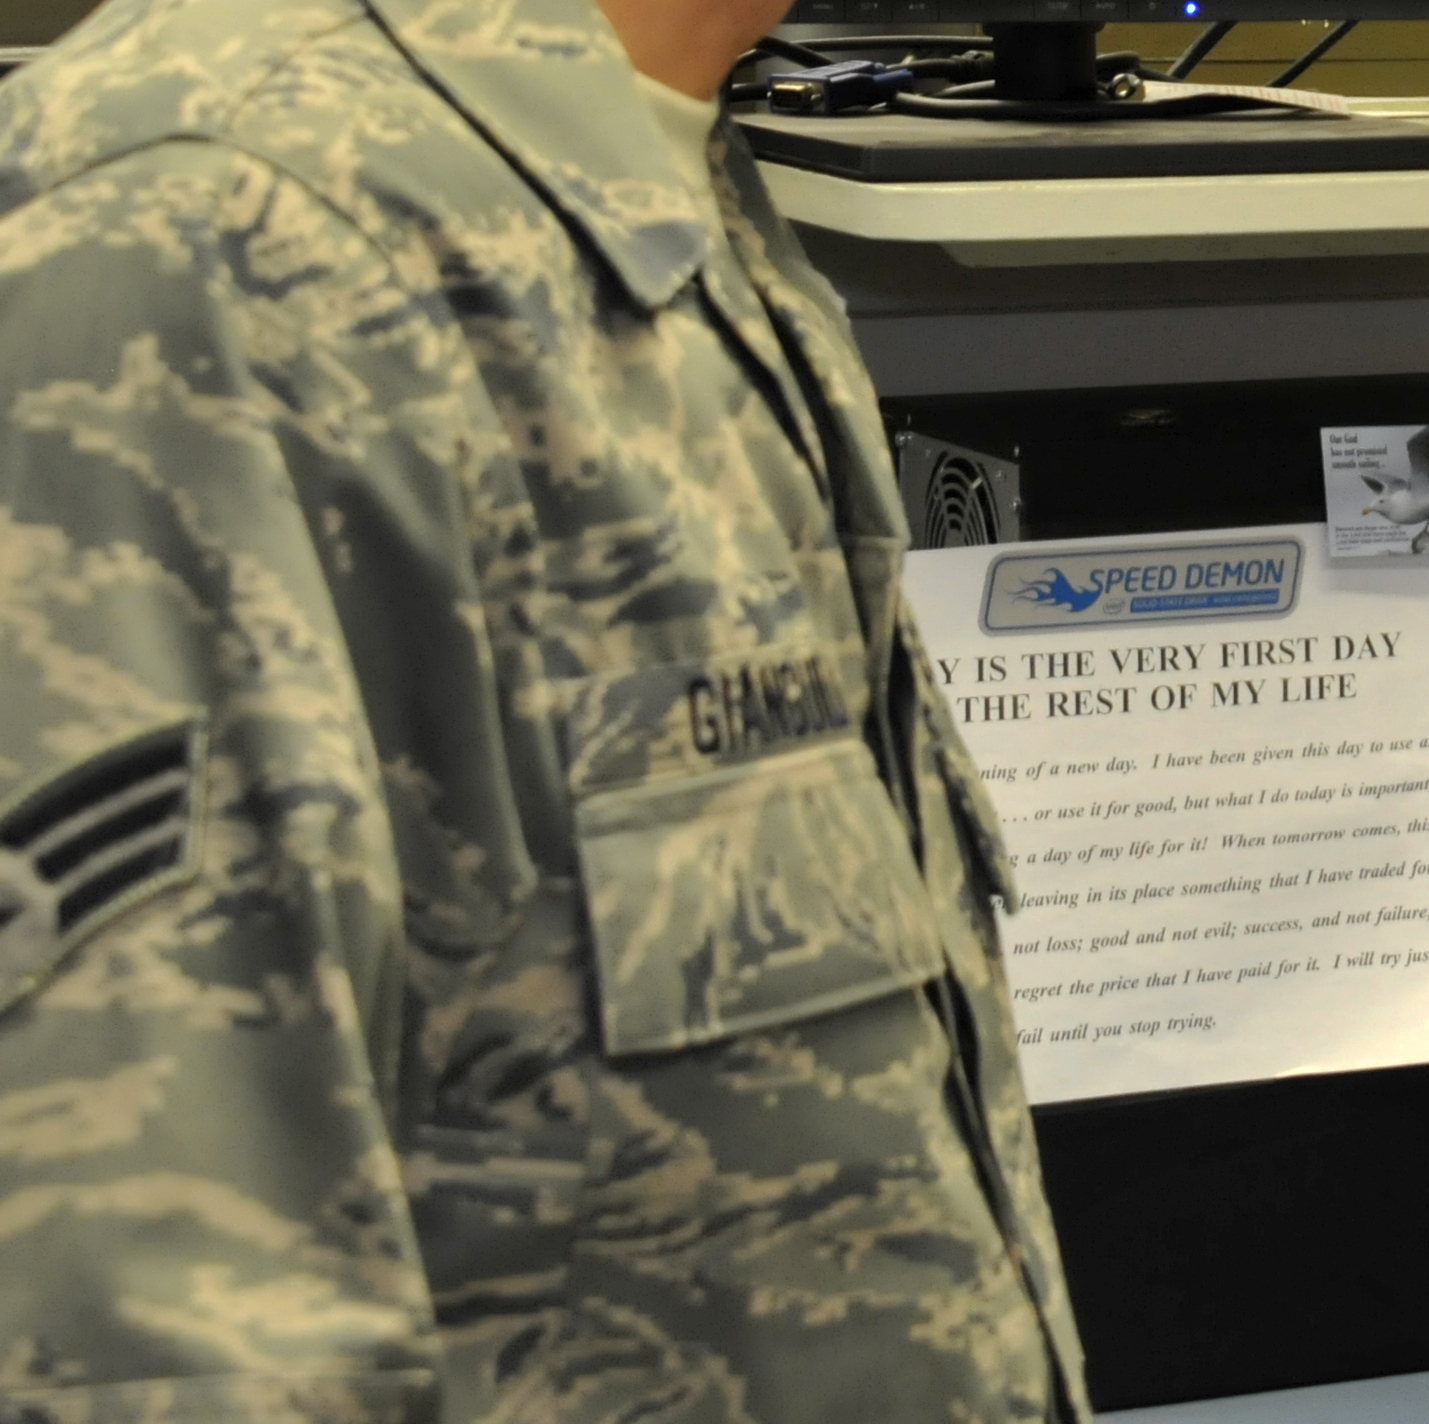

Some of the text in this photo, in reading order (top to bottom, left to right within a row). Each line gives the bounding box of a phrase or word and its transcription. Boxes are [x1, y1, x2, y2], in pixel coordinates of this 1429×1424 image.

[1089, 558, 1285, 594] SPEED DEMON
[975, 655, 1007, 683] IS
[1021, 650, 1096, 680] THE
[1109, 643, 1206, 674] VERY
[1220, 636, 1318, 669] FIRST
[1332, 631, 1402, 661] DAY
[957, 672, 1357, 723] THE REST OF MY LIFE
[1026, 761, 1046, 781] of
[1050, 764, 1060, 775] a
[1066, 762, 1099, 775] new
[1106, 757, 1137, 775] day.
[1152, 753, 1161, 769] I
[1166, 753, 1203, 768] have
[1210, 750, 1245, 765] been
[1253, 746, 1294, 766] given
[1301, 742, 1329, 758] this
[1337, 740, 1363, 758] day
[1369, 740, 1384, 753] to
[1389, 738, 1413, 751] use
[1034, 808, 1052, 821] or
[1057, 806, 1085, 819] use
[1090, 801, 1101, 817] it
[1104, 800, 1130, 820] for
[1134, 796, 1178, 818] good,
[1184, 795, 1210, 811] but
[1216, 791, 1253, 808] what
[1258, 789, 1267, 805] I
[1271, 788, 1289, 803] do
[1295, 785, 1335, 803] today
[1341, 783, 1353, 798] is
[1026, 852, 1037, 864] a
[1043, 847, 1072, 865] day
[1077, 845, 1096, 863] of
[1099, 846, 1123, 861] my
[1129, 841, 1155, 859] life
[1159, 839, 1184, 857] for
[1190, 836, 1209, 852] it!
[1221, 833, 1266, 849] When
[1272, 827, 1346, 846] tomorrow
[1352, 823, 1401, 839] comes,
[1020, 890, 1079, 908] leaving
[1087, 887, 1102, 903] in
[1109, 886, 1127, 902] its
[1132, 883, 1175, 904] place
[1181, 876, 1262, 895] something
[1269, 872, 1299, 889] that
[1304, 869, 1313, 885] I
[1318, 868, 1353, 884] have
[1359, 861, 1406, 880] traded
[1013, 940, 1040, 955] not
[1047, 936, 1083, 953] loss;
[1090, 930, 1130, 953] good
[1136, 927, 1166, 944] and
[1172, 926, 1198, 942] not
[1204, 921, 1237, 939] evil;
[1243, 919, 1303, 936] success,
[1312, 911, 1341, 928] and
[1346, 910, 1371, 925] not
[1013, 983, 1062, 1002] regret
[1069, 980, 1094, 995] the
[1099, 976, 1140, 996] price
[1145, 972, 1177, 988] that
[1183, 969, 1192, 984] I
[1196, 968, 1232, 983] have
[1237, 961, 1273, 983] paid
[1275, 959, 1301, 979] for
[1306, 956, 1320, 972] it.
[1333, 954, 1341, 969] I
[1347, 951, 1375, 968] will
[1380, 951, 1401, 967] try
[1016, 1013, 1217, 1047] fail until you stop trying.
